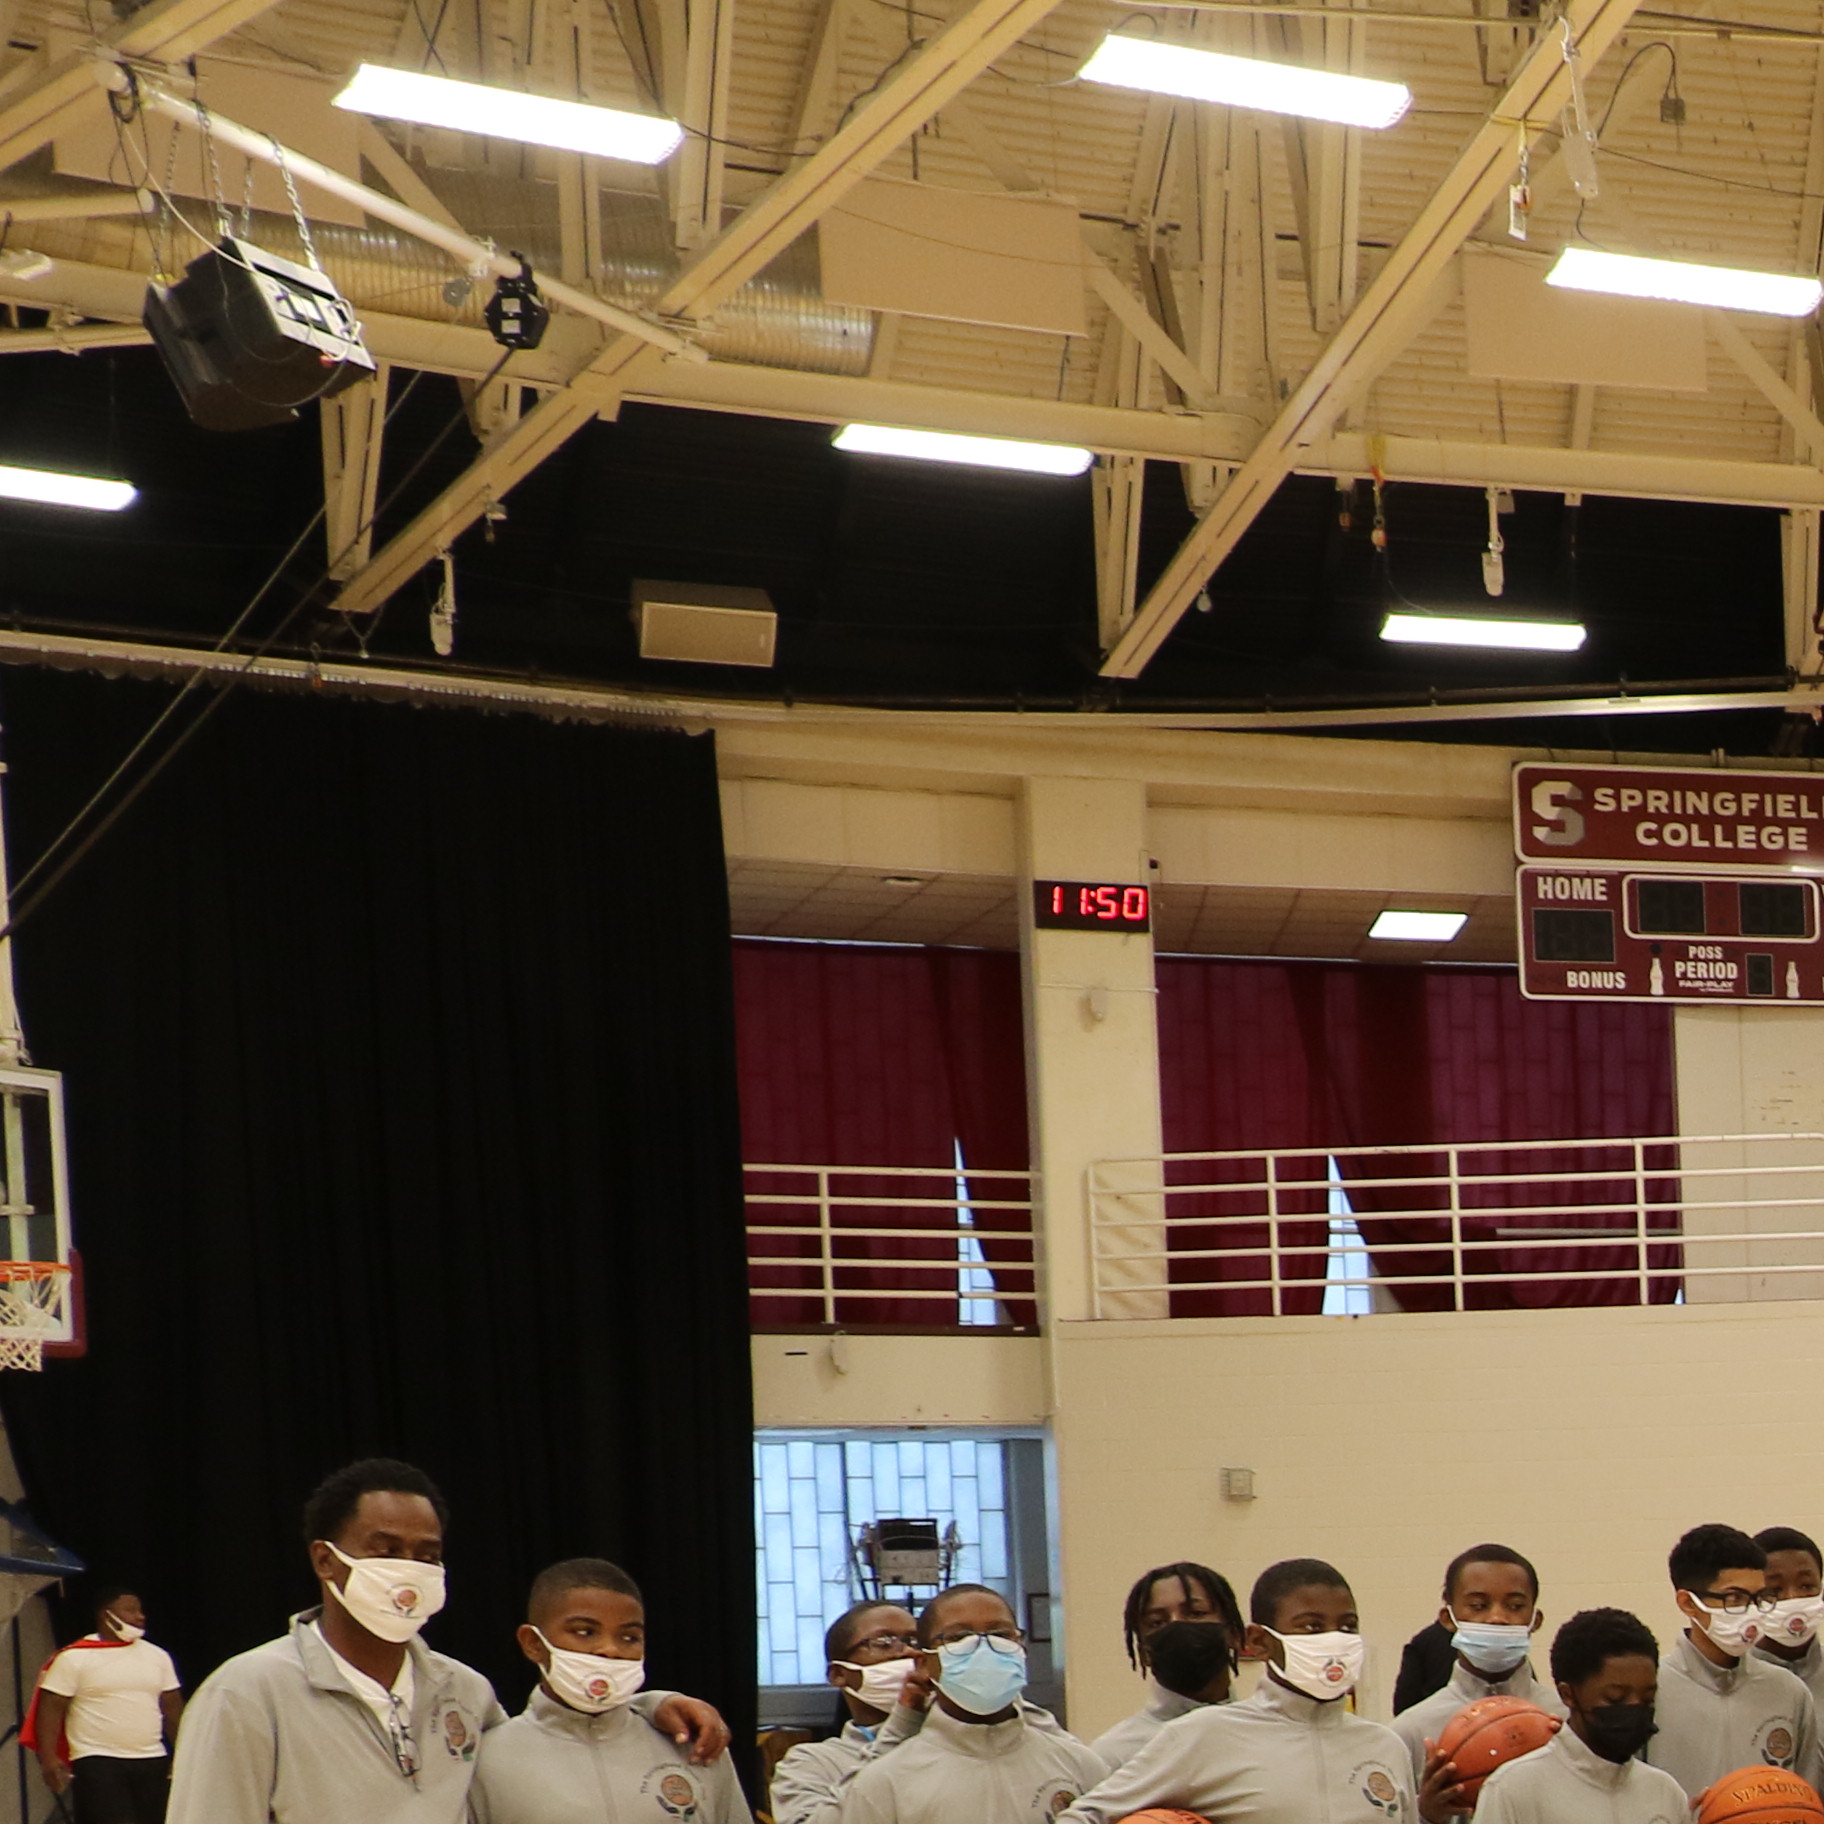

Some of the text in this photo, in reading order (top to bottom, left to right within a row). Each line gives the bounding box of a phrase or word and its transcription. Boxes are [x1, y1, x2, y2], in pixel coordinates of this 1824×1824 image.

[1635, 821, 1809, 851] COLLEGE
[1536, 876, 1608, 901] HOME
[1052, 886, 1148, 920] 11:50
[1688, 945, 1723, 960] POSS
[1566, 971, 1626, 989] BONUS
[1674, 961, 1738, 979] PERIOD
